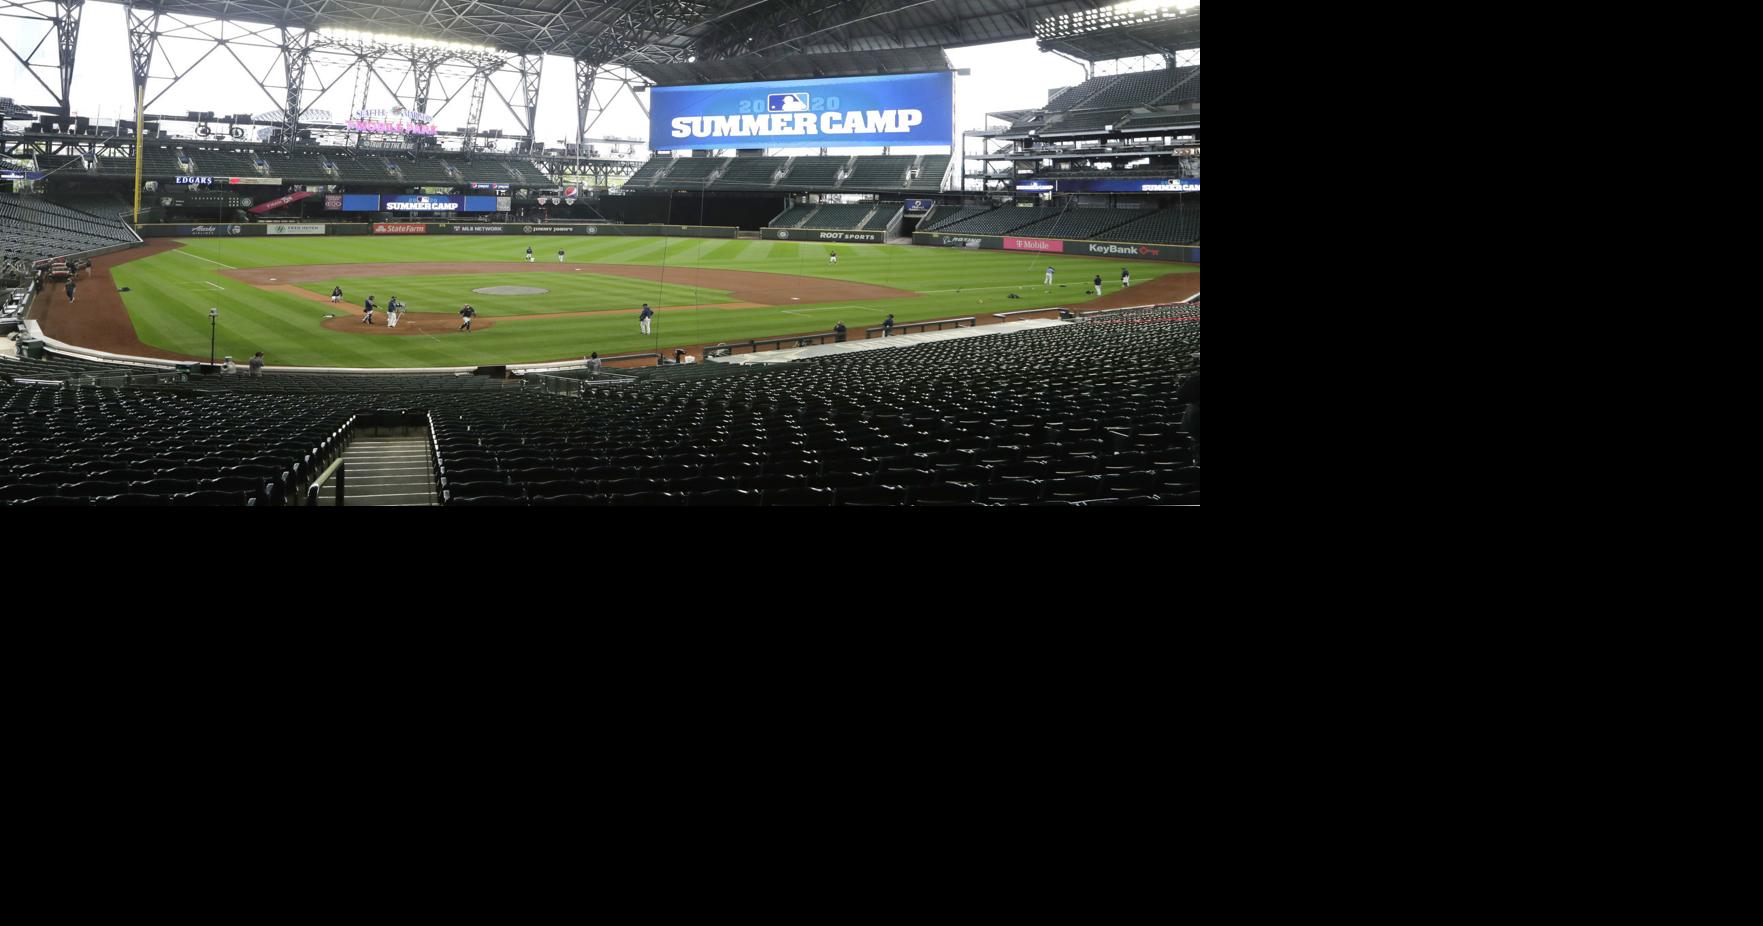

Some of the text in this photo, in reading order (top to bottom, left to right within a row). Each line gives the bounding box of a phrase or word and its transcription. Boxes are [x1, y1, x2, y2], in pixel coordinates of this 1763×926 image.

[739, 96, 840, 113] 20 20
[671, 108, 923, 138] SUMMER CAMP
[386, 202, 458, 211] SUMMER CAMP
[1089, 244, 1138, 255] KeyBank
